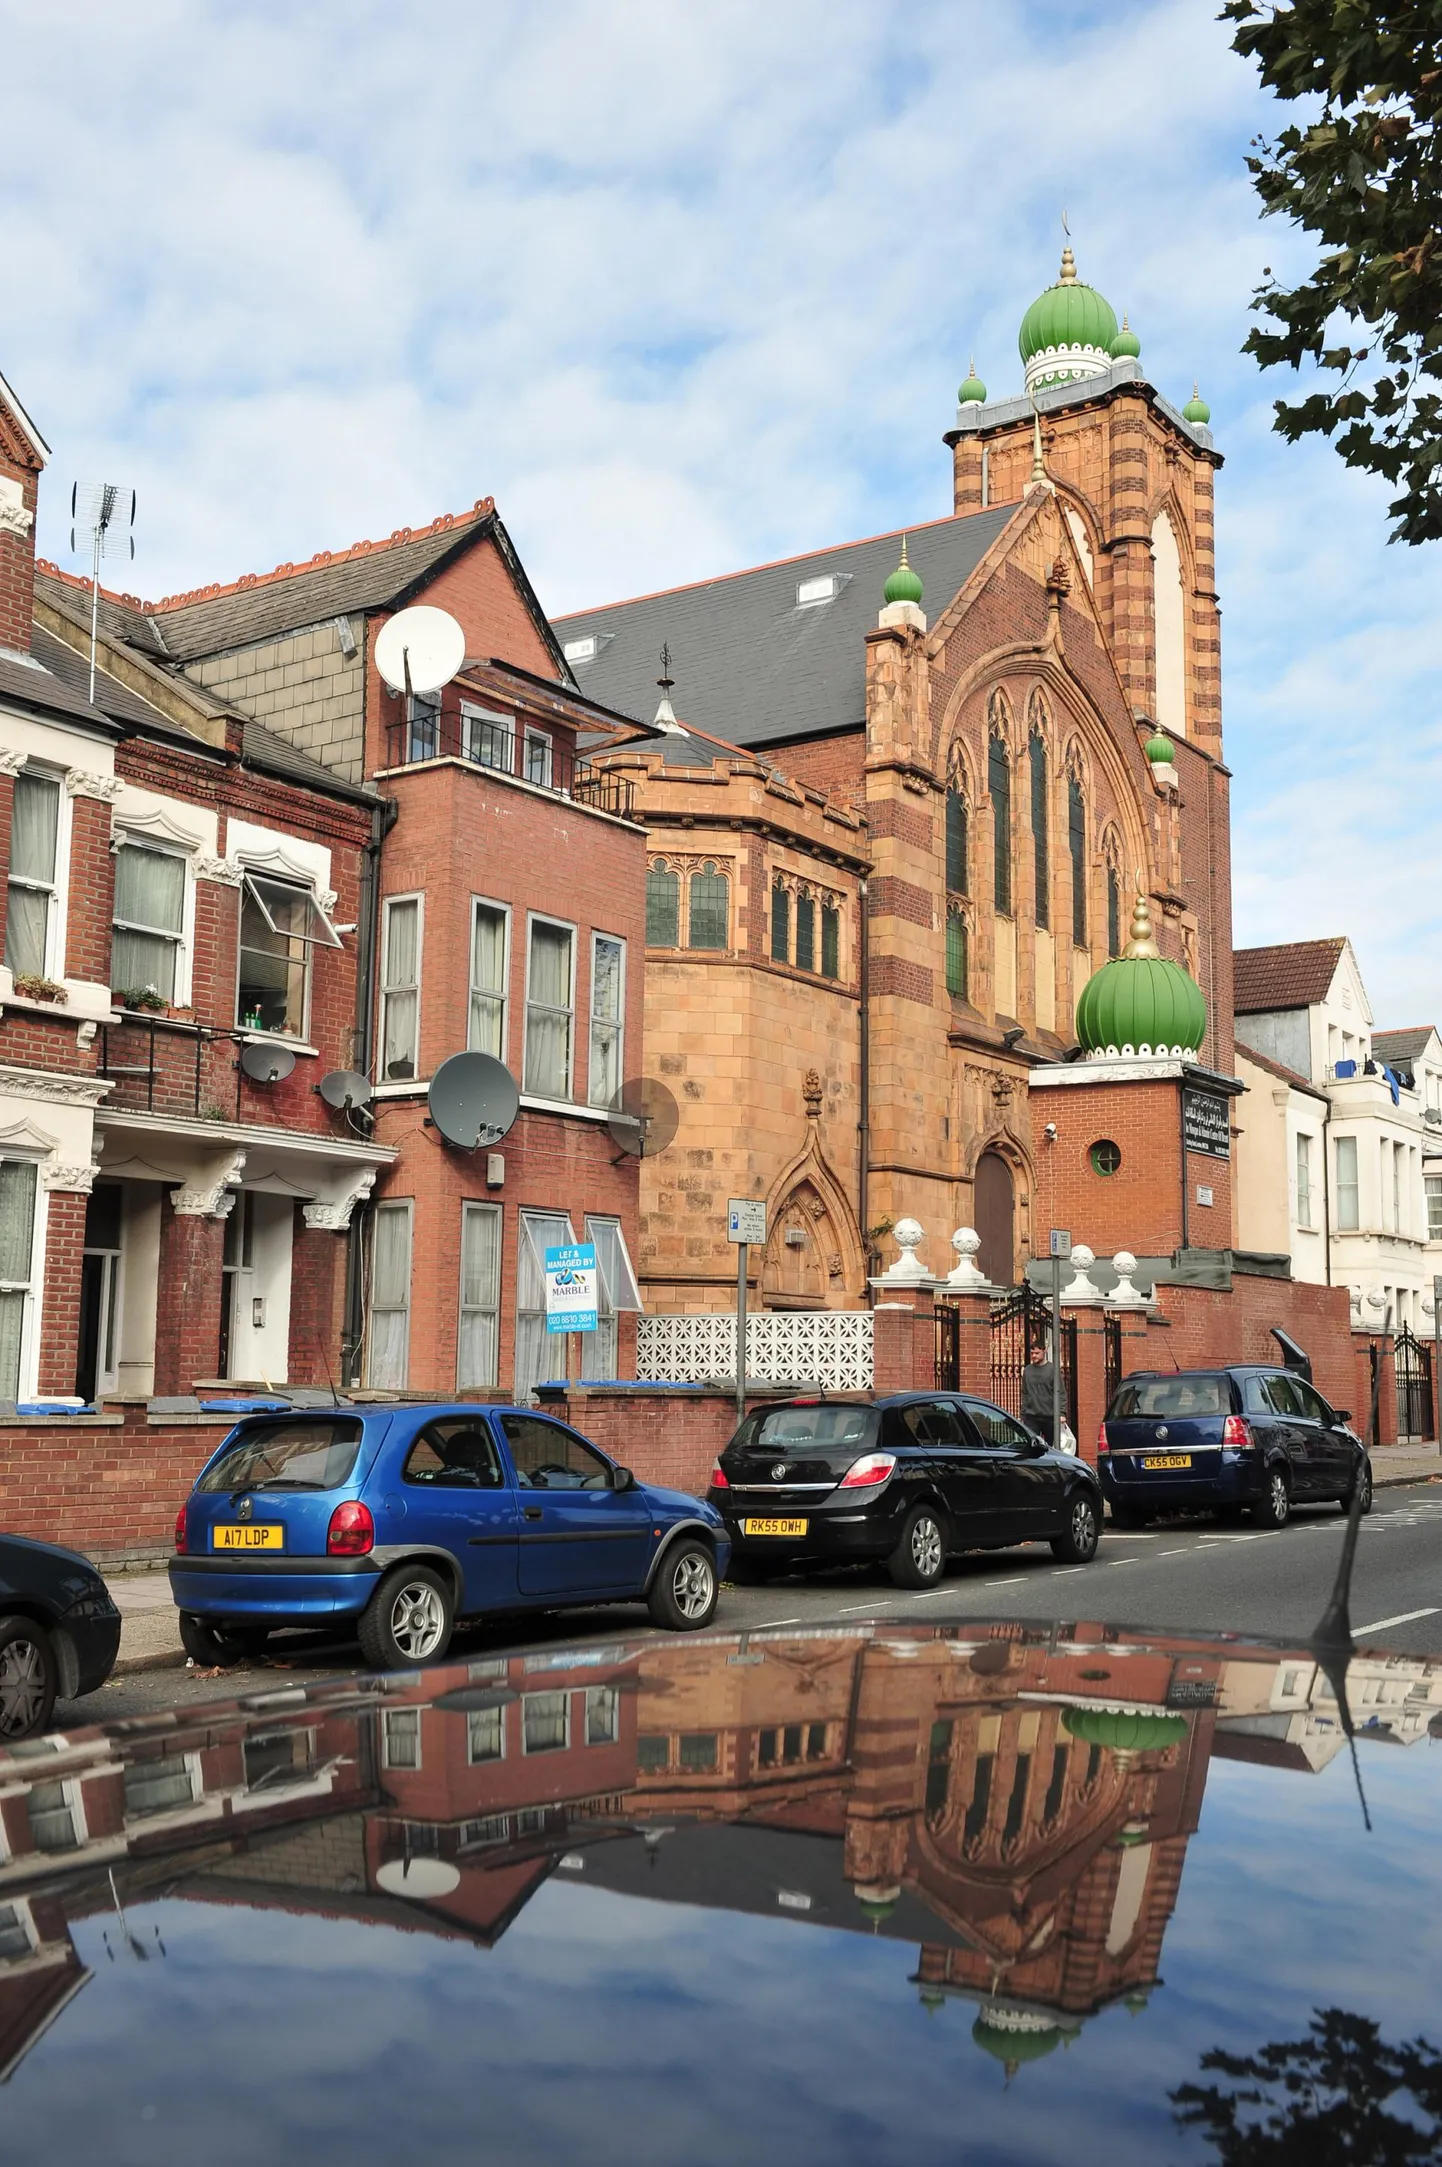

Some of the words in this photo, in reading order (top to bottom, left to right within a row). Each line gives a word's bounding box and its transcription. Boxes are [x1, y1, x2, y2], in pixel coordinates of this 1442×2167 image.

[730, 1212, 738, 1230] P
[559, 1250, 572, 1259] LET
[573, 1250, 579, 1258] &
[547, 1259, 582, 1269] MANAGED
[583, 1258, 594, 1266] BY
[552, 1286, 590, 1296] MARBLE
[1144, 1457, 1168, 1468] CK55
[1169, 1456, 1187, 1466] OGV
[750, 1520, 778, 1532] RK55
[780, 1520, 802, 1532] OWH
[224, 1529, 242, 1546] A17
[245, 1529, 269, 1546] LDP
